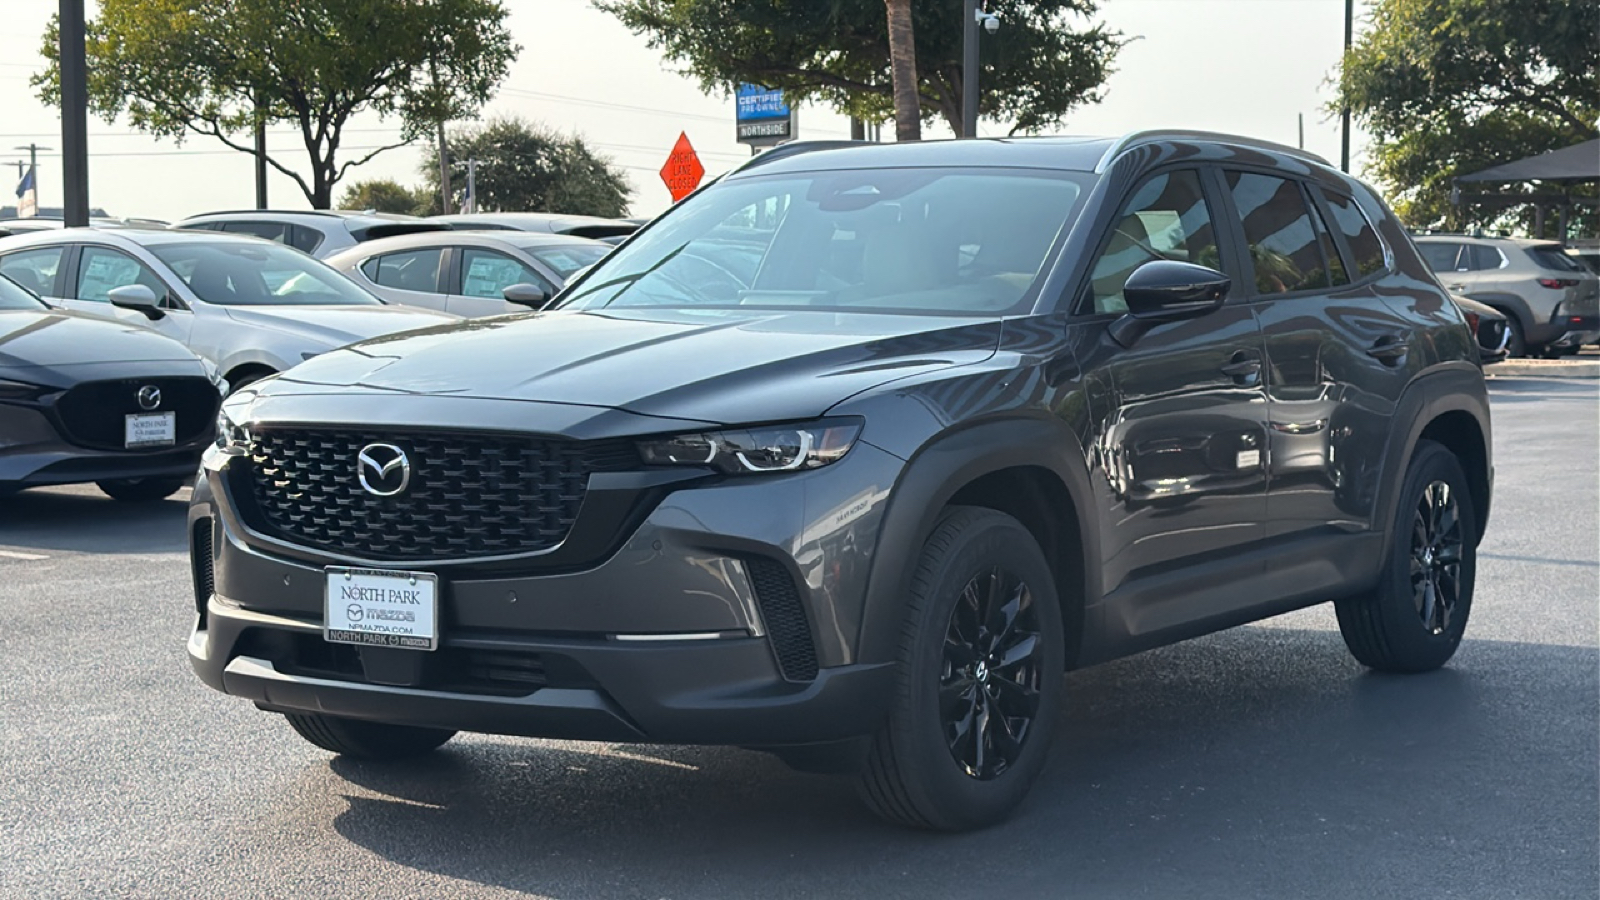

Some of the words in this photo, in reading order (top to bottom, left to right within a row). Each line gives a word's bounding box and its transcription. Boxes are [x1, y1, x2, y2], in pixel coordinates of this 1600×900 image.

[741, 124, 785, 136] NORTHSIDE
[672, 152, 693, 164] RIGHT
[673, 164, 692, 177] LANE
[669, 177, 697, 190] CLOSED
[341, 584, 385, 602] NORTH
[388, 589, 420, 605] PARK
[366, 608, 416, 622] mazda
[348, 623, 413, 635] NPMAZDA.COM
[330, 630, 361, 642] NORTH
[363, 634, 387, 645] PARK
[400, 637, 430, 647] mazda
